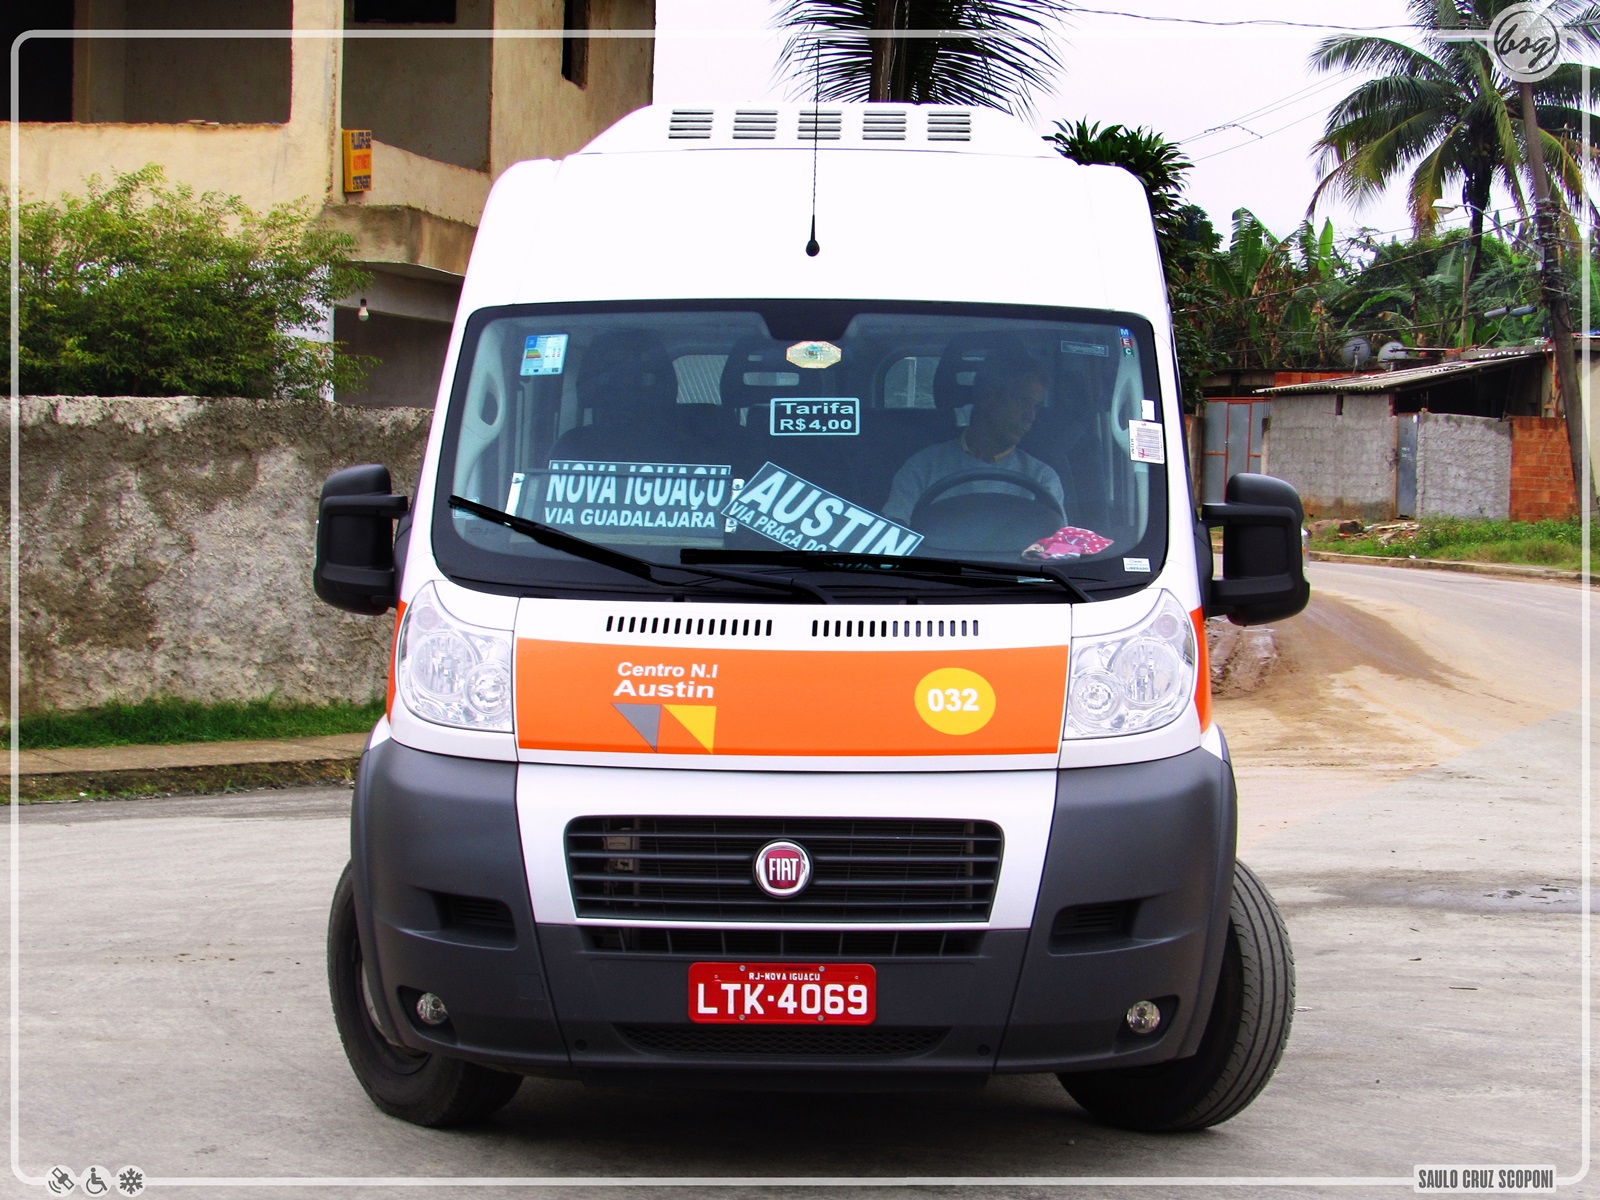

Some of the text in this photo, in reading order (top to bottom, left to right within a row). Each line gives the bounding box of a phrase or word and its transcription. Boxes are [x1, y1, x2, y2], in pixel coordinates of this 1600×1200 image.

[780, 402, 854, 415] Tarifa
[780, 417, 852, 432] R$4,00
[546, 463, 727, 510] NOVA IGUAÇU
[544, 507, 716, 528] VIA GUADALAJARA
[729, 501, 756, 524] VIA
[738, 470, 918, 557] AUSTIN
[617, 661, 719, 678] Centro N.I
[613, 679, 715, 698] Austin
[927, 687, 980, 713] 032
[768, 857, 799, 881] FIAT
[748, 972, 787, 981] RJ-NOVA
